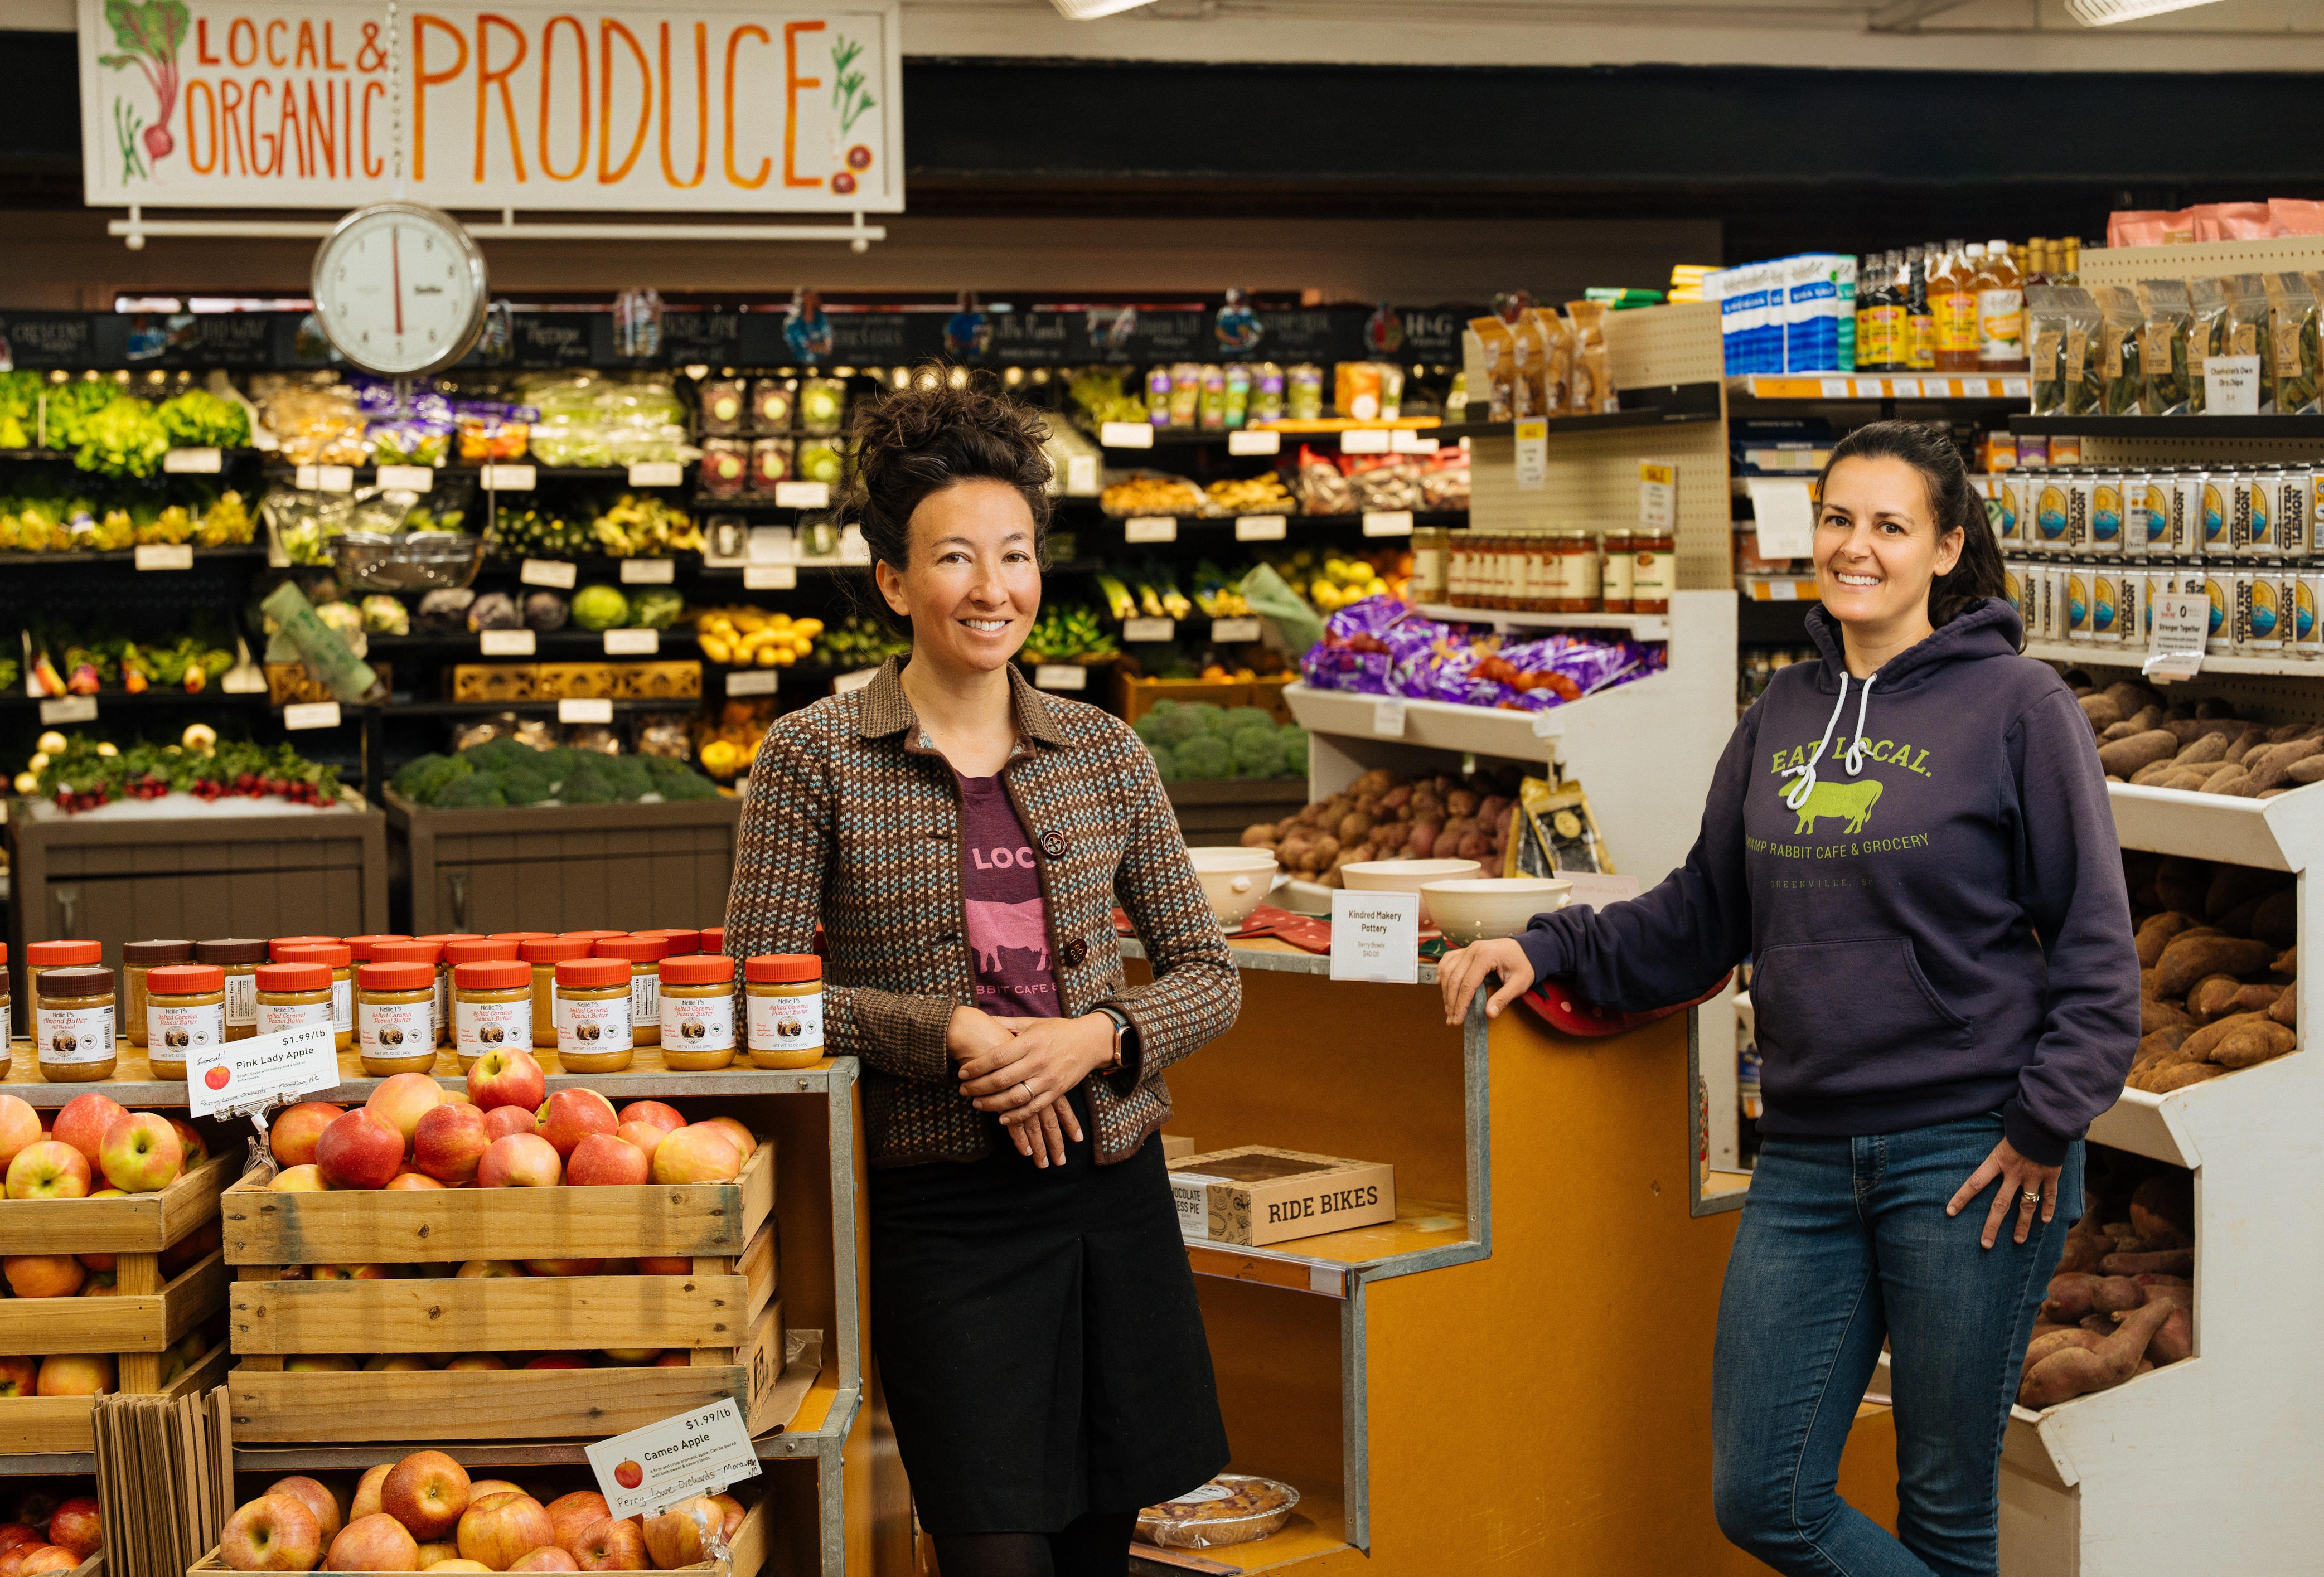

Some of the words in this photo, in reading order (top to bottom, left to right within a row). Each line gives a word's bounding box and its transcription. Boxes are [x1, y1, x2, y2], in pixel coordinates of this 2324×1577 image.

[197, 17, 348, 73] LOCAL
[411, 12, 827, 190] PRODUCE
[185, 78, 385, 178] ORGANIC
[2077, 492, 2085, 538] LEMON
[2241, 491, 2249, 541] LEMON
[2292, 489, 2302, 540] LEMON
[2126, 584, 2134, 631] LEMON
[1771, 740, 1823, 774] EAT
[972, 846, 1037, 870] LOC
[1746, 834, 1767, 852] WAMP
[1770, 842, 1812, 859] RABBIT
[1817, 845, 1847, 859] CAFE
[1851, 843, 1859, 856] &
[1863, 833, 1929, 853] GROCERY
[1349, 910, 1374, 919] Kindred
[1376, 911, 1401, 921] Makery
[1362, 924, 1387, 934] Pottery
[1014, 983, 1048, 994] CAFE
[283, 1030, 325, 1045] $1.99/lb
[236, 1059, 258, 1069] Pink
[261, 1054, 283, 1064] Lady
[287, 1047, 314, 1059] Apple
[200, 1099, 220, 1110] Perry
[1176, 1201, 1188, 1212] ESS
[1190, 1203, 1200, 1214] PIE
[1268, 1197, 1315, 1224] RIDE
[1320, 1186, 1378, 1214] BIKES
[686, 1409, 731, 1430] $1.99/lb
[644, 1445, 679, 1461] Cameo
[682, 1433, 710, 1449] Apple
[681, 1455, 697, 1463] aromatic
[617, 1495, 647, 1507] Perry
[651, 1487, 675, 1499] Lowe
[679, 1470, 715, 1489] Orchards
